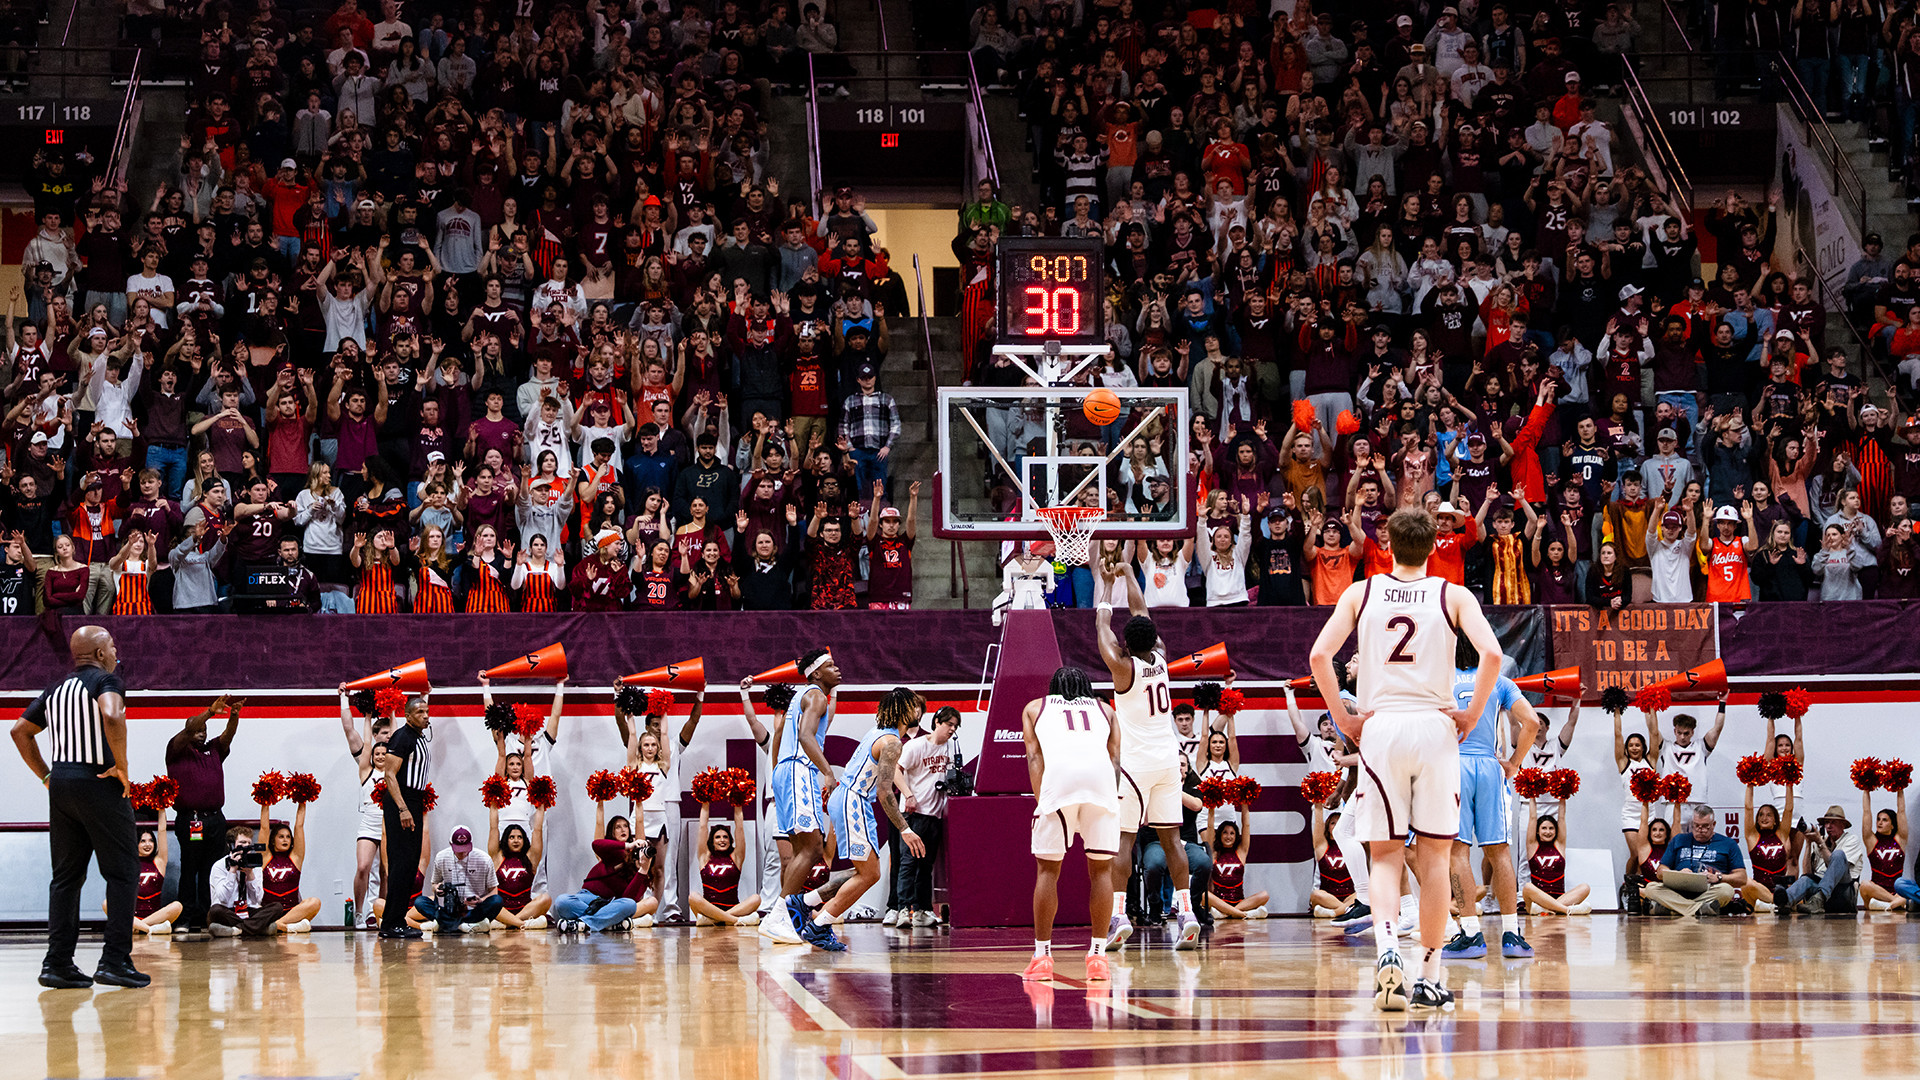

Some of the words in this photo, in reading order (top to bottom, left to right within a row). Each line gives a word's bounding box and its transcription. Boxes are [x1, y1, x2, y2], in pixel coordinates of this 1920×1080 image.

[18, 106, 44, 120] 117
[63, 106, 91, 120] 118
[856, 109, 884, 123] 118
[900, 109, 925, 123] 101
[1669, 111, 1696, 125] 101
[1711, 111, 1740, 125] 102
[46, 130, 64, 144] EXIT
[881, 133, 899, 147] EXIT
[1264, 179, 1280, 192] 20
[1546, 211, 1566, 231] 25
[595, 233, 608, 254] 7
[1030, 255, 1087, 283] 9:07
[485, 312, 506, 322] VT
[1025, 287, 1079, 335] 30
[1620, 362, 1631, 376] 2
[801, 371, 818, 385] 25
[1582, 465, 1593, 480] 0
[252, 520, 273, 537] 20
[885, 550, 900, 563] 12
[1711, 553, 1743, 566] Hokies
[1723, 566, 1735, 582] 5
[647, 582, 667, 599] 20
[1383, 588, 1428, 604] SCHUTT
[2, 596, 18, 614] 19
[1554, 611, 1590, 632] IT'S
[1597, 610, 1612, 632] A
[1618, 610, 1667, 631] GOOD
[1674, 608, 1712, 630] DAY
[1384, 614, 1418, 665] 2
[1592, 640, 1617, 662] TO
[1623, 640, 1648, 662] BE
[1655, 640, 1671, 661] A
[1142, 664, 1166, 678] JOHNSON
[1144, 682, 1170, 716] 10
[1062, 709, 1091, 731] 11
[1532, 753, 1554, 766] VT
[1673, 752, 1696, 764] VT
[1760, 845, 1784, 857] VT
[1876, 849, 1901, 861] VT
[1537, 855, 1561, 868] VT
[268, 867, 293, 880] VT
[501, 868, 527, 879] VT
[709, 864, 733, 875] VT
[1215, 864, 1241, 876] VT
